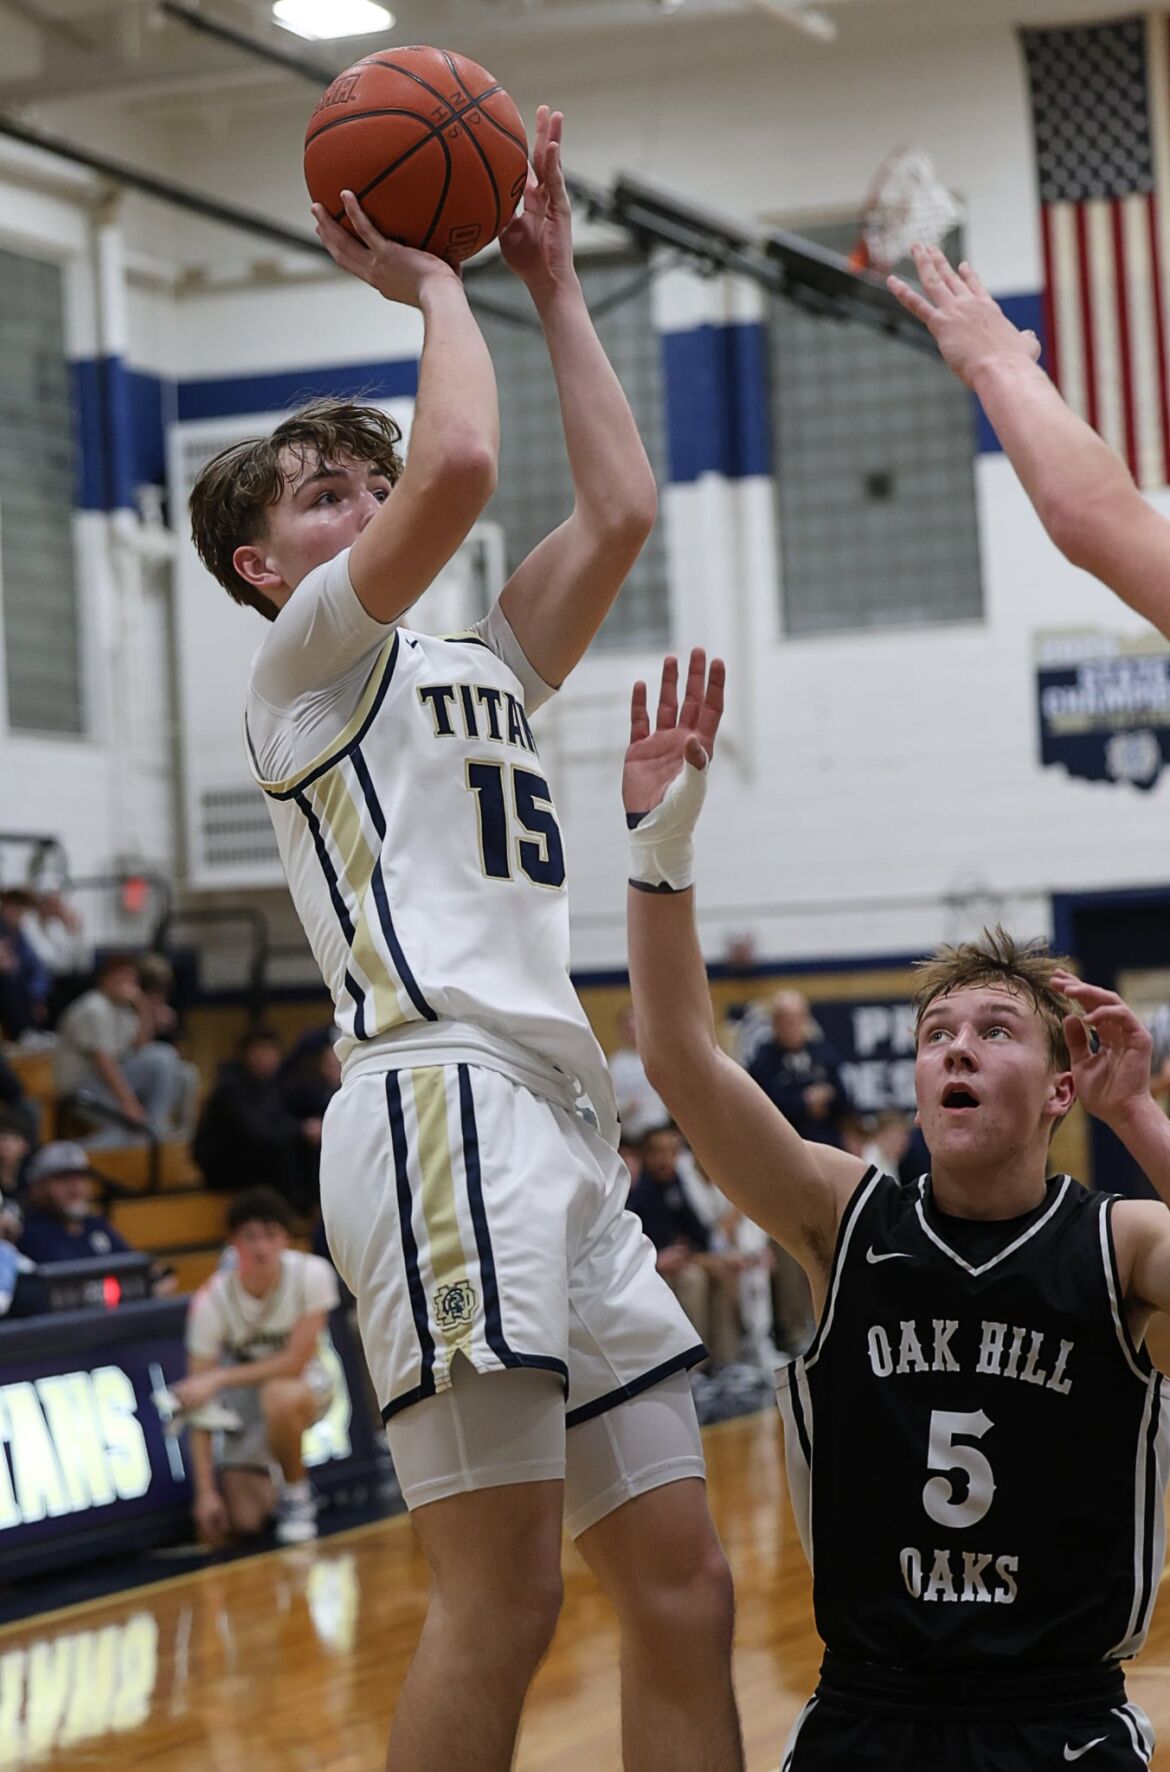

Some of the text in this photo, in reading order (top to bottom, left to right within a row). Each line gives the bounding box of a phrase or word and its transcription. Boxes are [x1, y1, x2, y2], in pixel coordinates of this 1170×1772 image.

[464, 758, 568, 892] 15
[867, 1319, 1074, 1395] OAK HILL
[922, 1408, 997, 1528] 5
[899, 1546, 1019, 1604] OAKS
